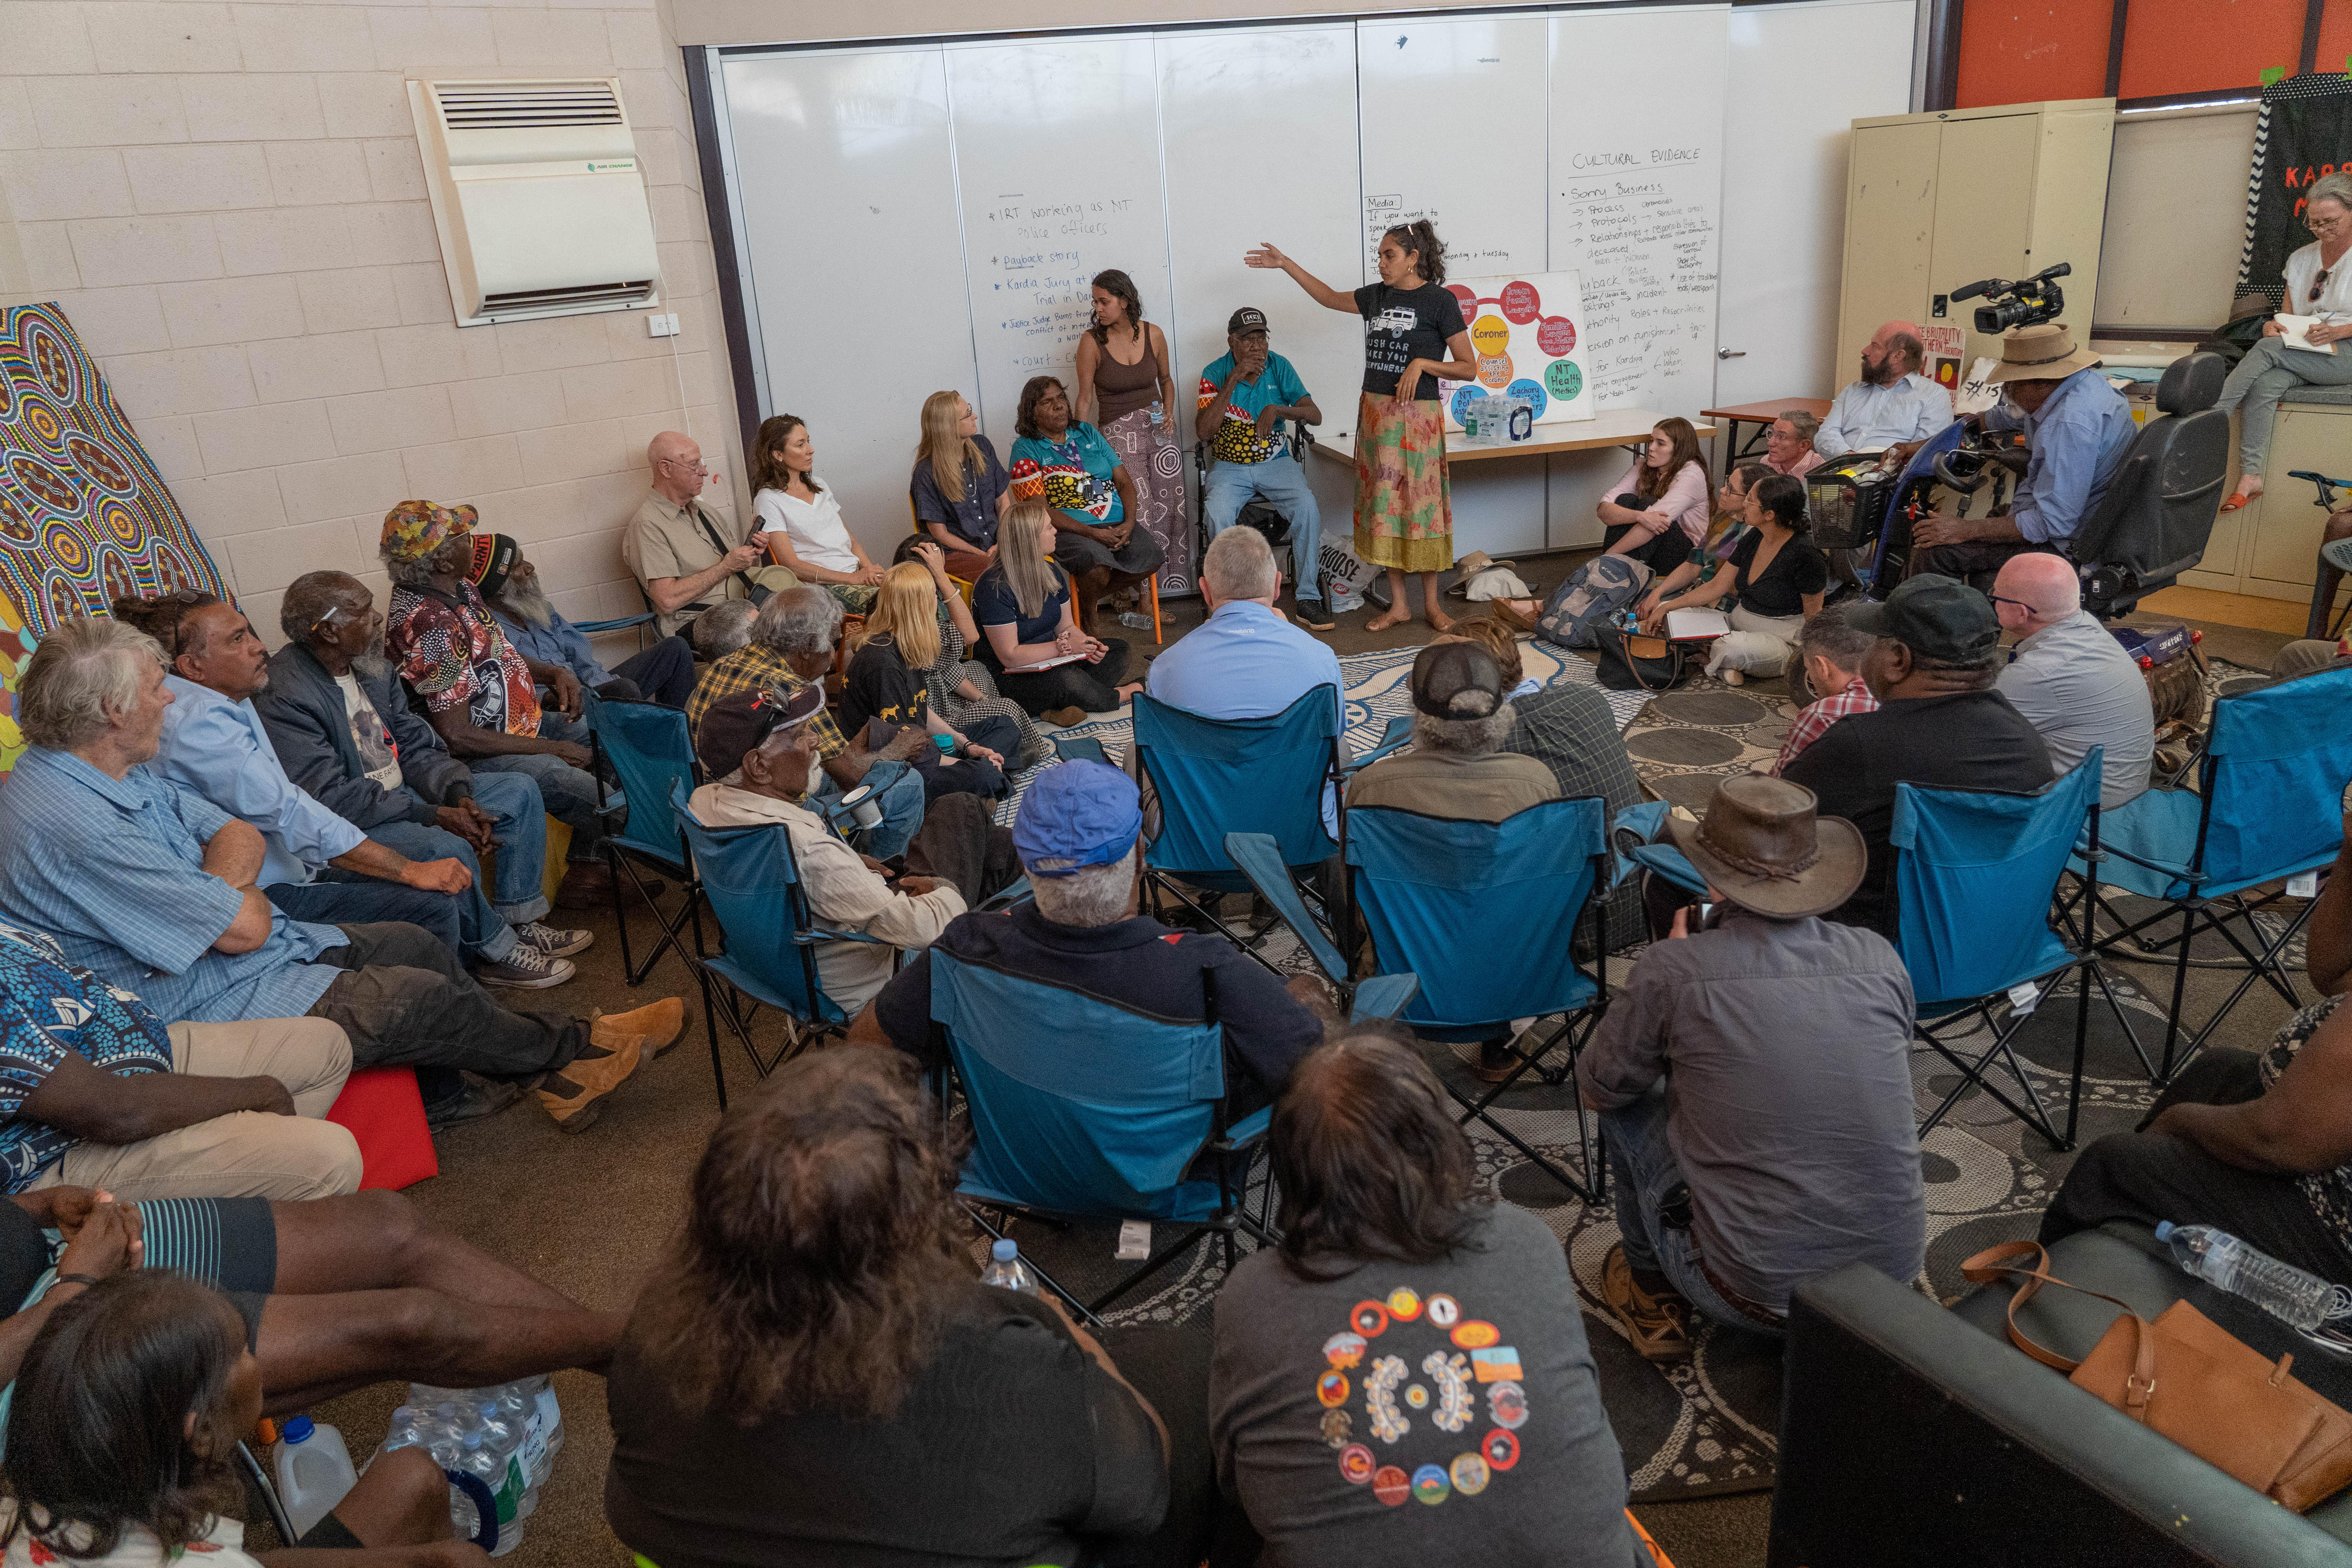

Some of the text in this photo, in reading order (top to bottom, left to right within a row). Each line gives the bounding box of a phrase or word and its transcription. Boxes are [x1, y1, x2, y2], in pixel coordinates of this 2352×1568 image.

[1572, 148, 1700, 169] CULTURAL EVIDENCE
[1571, 182, 1663, 204] Sorry Business
[1368, 199, 1397, 208] Media:
[1000, 199, 1133, 222] IRT working as NT
[1368, 208, 1438, 223] If you want to
[1588, 205, 1624, 216] Process
[1061, 220, 1107, 236] officers
[1369, 224, 1387, 233] speak
[1590, 228, 1642, 243] Relationships
[1700, 235, 1707, 245] of
[1444, 252, 1469, 261] monday
[1587, 245, 1628, 259] deceased
[1049, 251, 1080, 270] story
[1678, 261, 1702, 269] authority
[1689, 271, 1695, 281] of
[1007, 278, 1038, 290] Kardia
[1044, 277, 1070, 292] Jury
[1076, 275, 1087, 285] at
[1581, 275, 1621, 295] yback
[1507, 287, 1530, 296] Brown
[1637, 287, 1667, 300] incident
[1033, 292, 1056, 305] Trial
[1506, 296, 1531, 305] Family
[1506, 305, 1536, 317] Lawyers
[1584, 300, 1614, 311] eetings
[1631, 308, 1651, 319] Roles
[1009, 318, 1031, 328] Justice
[1033, 316, 1051, 326] Judge
[1586, 314, 1620, 331] thority
[1026, 326, 1054, 336] conflict
[1474, 328, 1508, 339] Coroner
[1926, 326, 1961, 343] BRUTALITY
[1389, 342, 1409, 352] CAR
[1588, 335, 1629, 352] cision on
[1387, 352, 1407, 363] YOU
[1480, 357, 1508, 366] Counsel
[1366, 361, 1406, 374] ERYWHERE
[1480, 365, 1510, 374] assisting
[1555, 364, 1570, 375] NT
[1596, 359, 1609, 373] for
[1551, 374, 1581, 386] Health
[1459, 390, 1472, 399] NT
[1511, 386, 1539, 397] Zachary
[1552, 387, 1578, 396] (Medics)
[1598, 392, 1608, 401] for
[528, 1439, 540, 1457] RING
